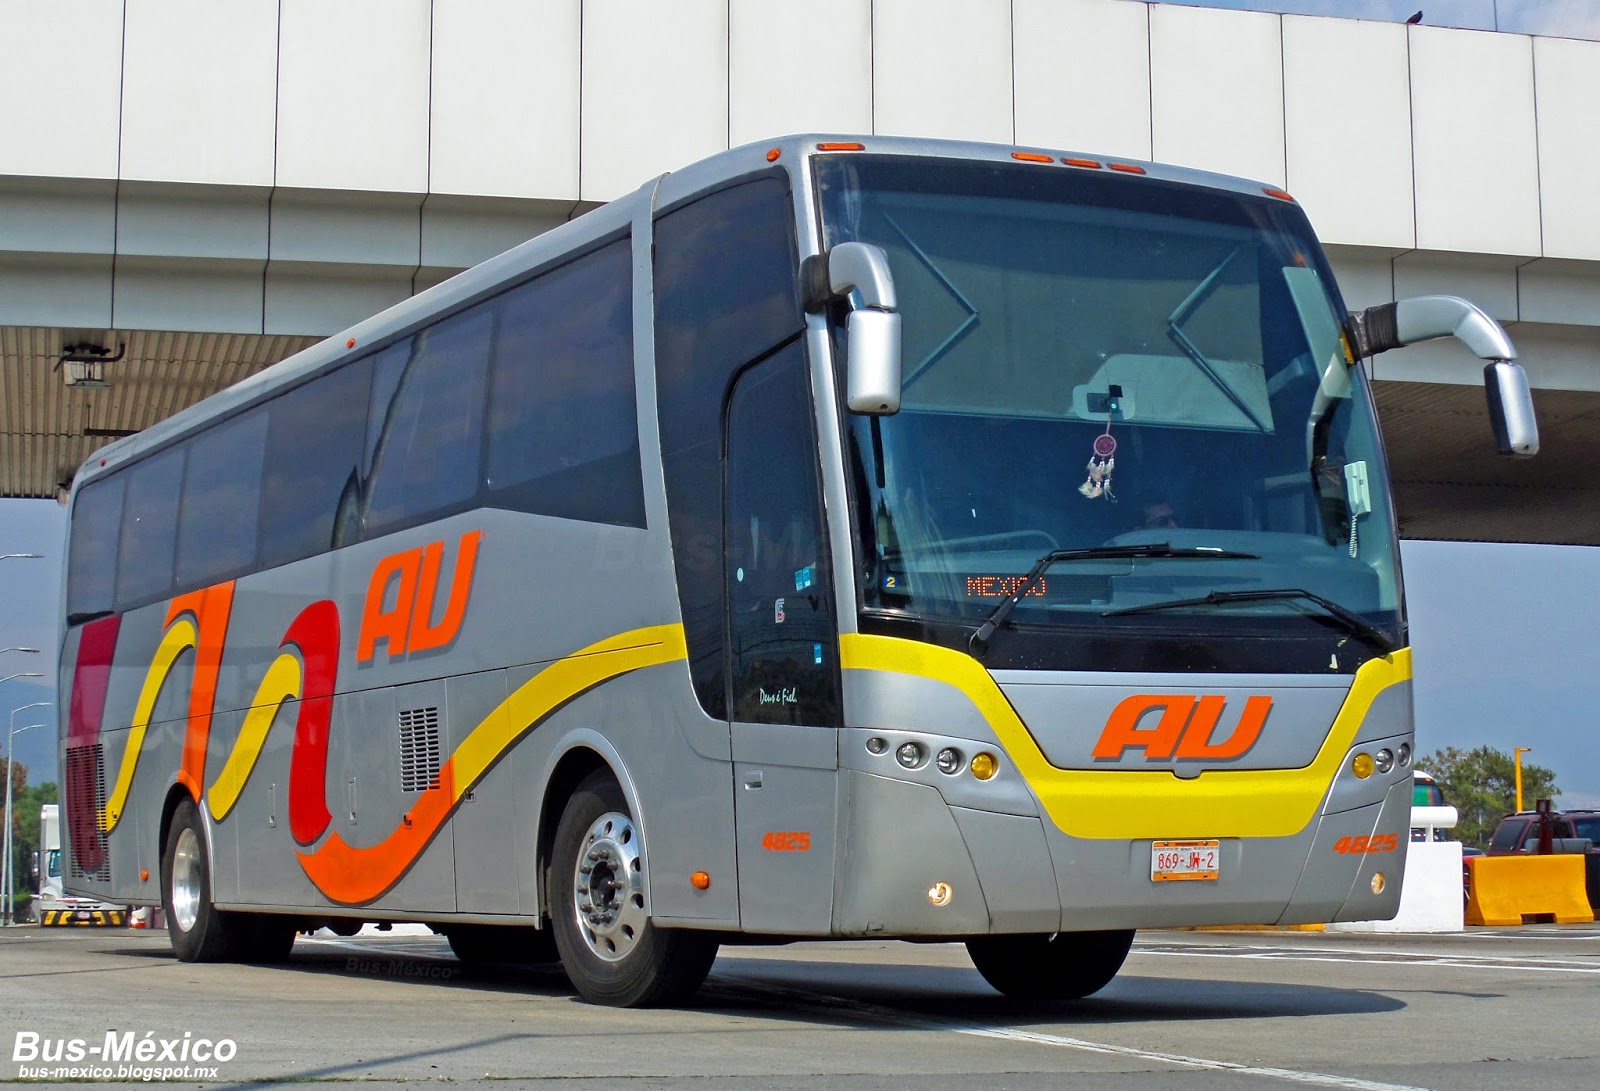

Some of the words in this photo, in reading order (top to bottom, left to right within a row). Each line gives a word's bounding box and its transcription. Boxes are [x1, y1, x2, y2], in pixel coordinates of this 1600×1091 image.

[886, 576, 896, 588] 2
[355, 528, 481, 668] AU
[1090, 694, 1275, 763] AU
[761, 831, 811, 851] 4825
[1333, 832, 1399, 855] 4825
